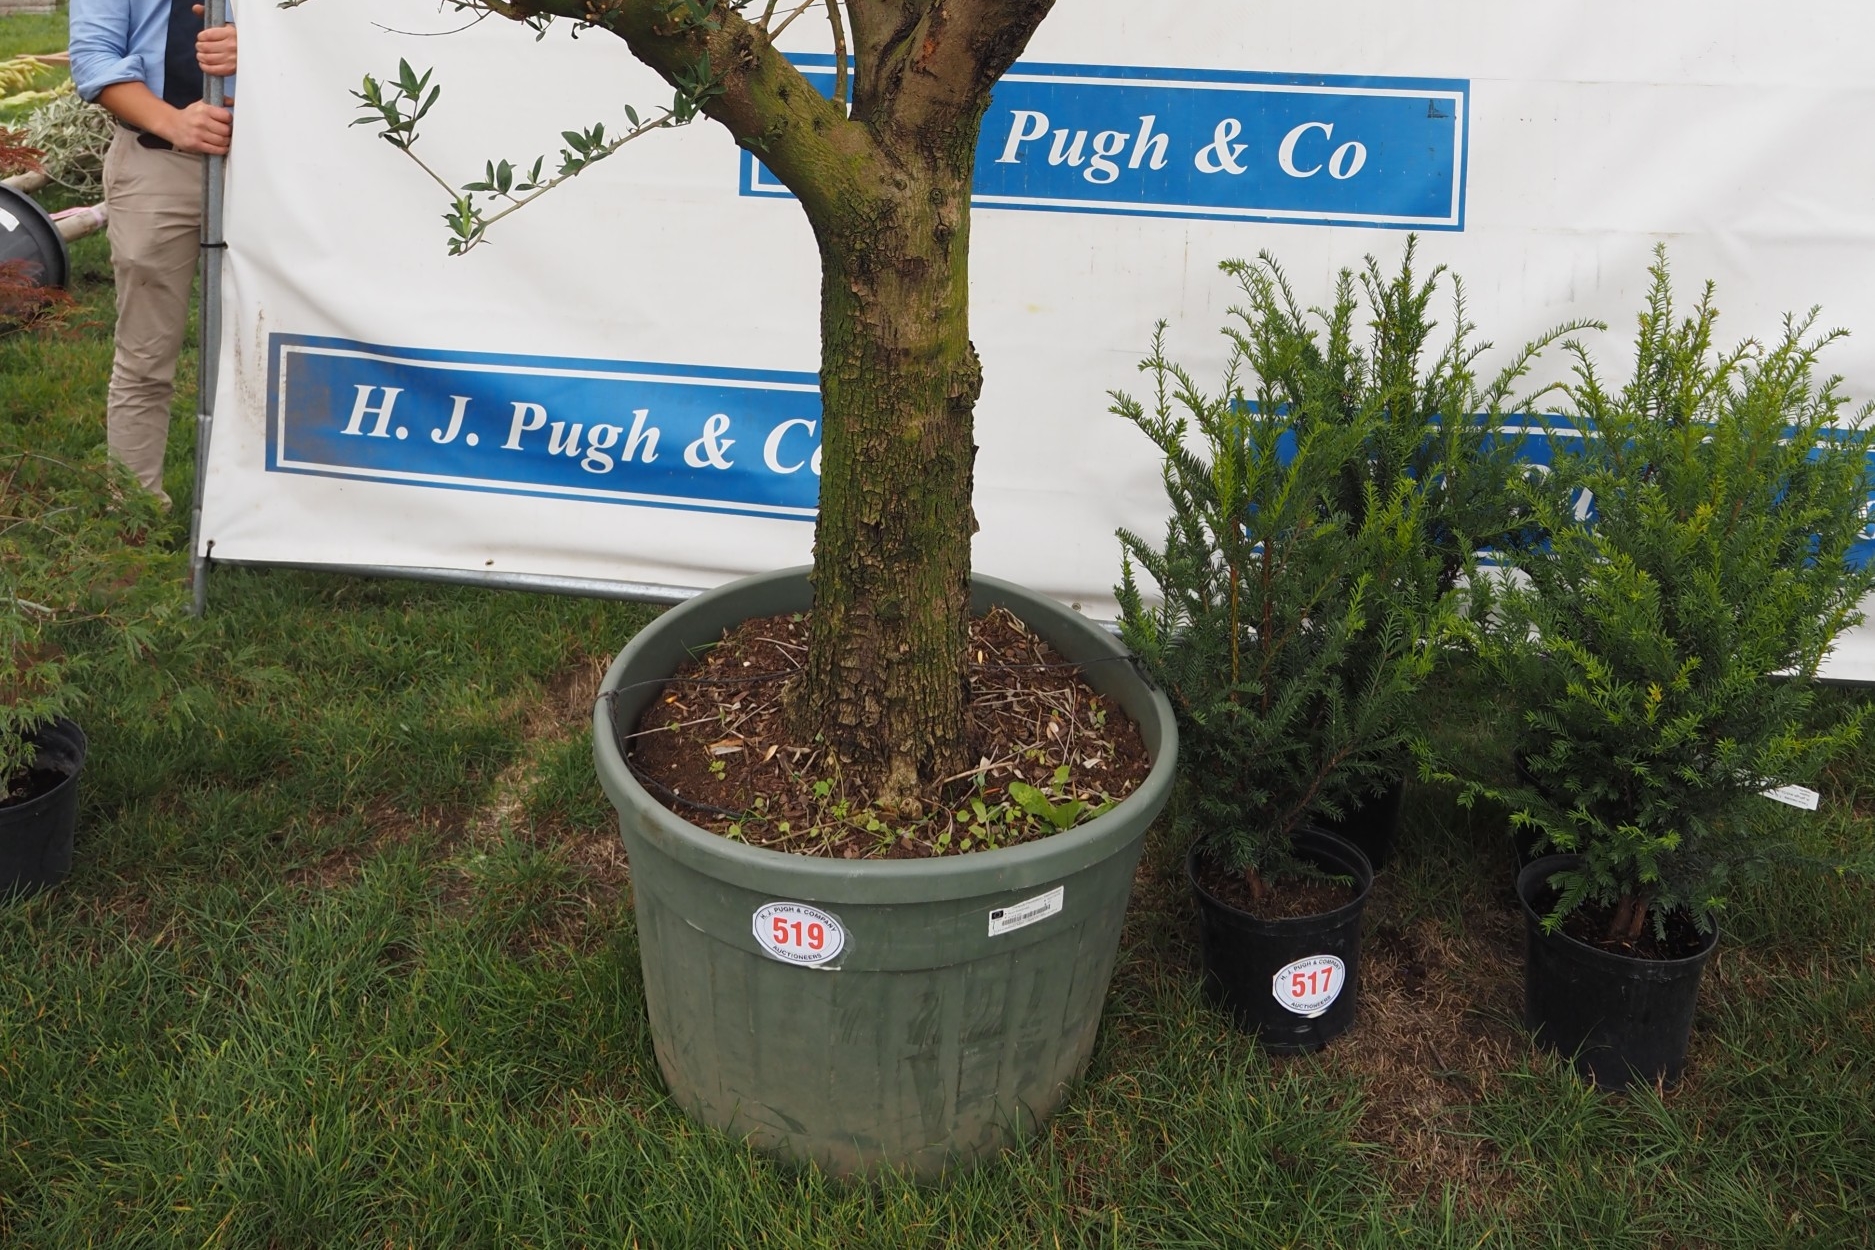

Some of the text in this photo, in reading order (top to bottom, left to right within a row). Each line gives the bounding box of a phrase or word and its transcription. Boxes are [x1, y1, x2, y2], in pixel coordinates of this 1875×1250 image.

[995, 110, 1367, 184] Pugh & Co
[340, 384, 409, 440] H.
[431, 395, 479, 447] J.
[501, 401, 661, 474] Pugh
[683, 413, 736, 470] &
[773, 917, 824, 950] 519
[804, 910, 837, 932] COMPANY
[773, 945, 822, 960] AUCTIONEERS
[1294, 961, 1311, 971] PUGH
[1319, 959, 1341, 970] COMPANY
[1292, 966, 1333, 997] 517
[1291, 995, 1332, 1009] AUCTIONEERS
